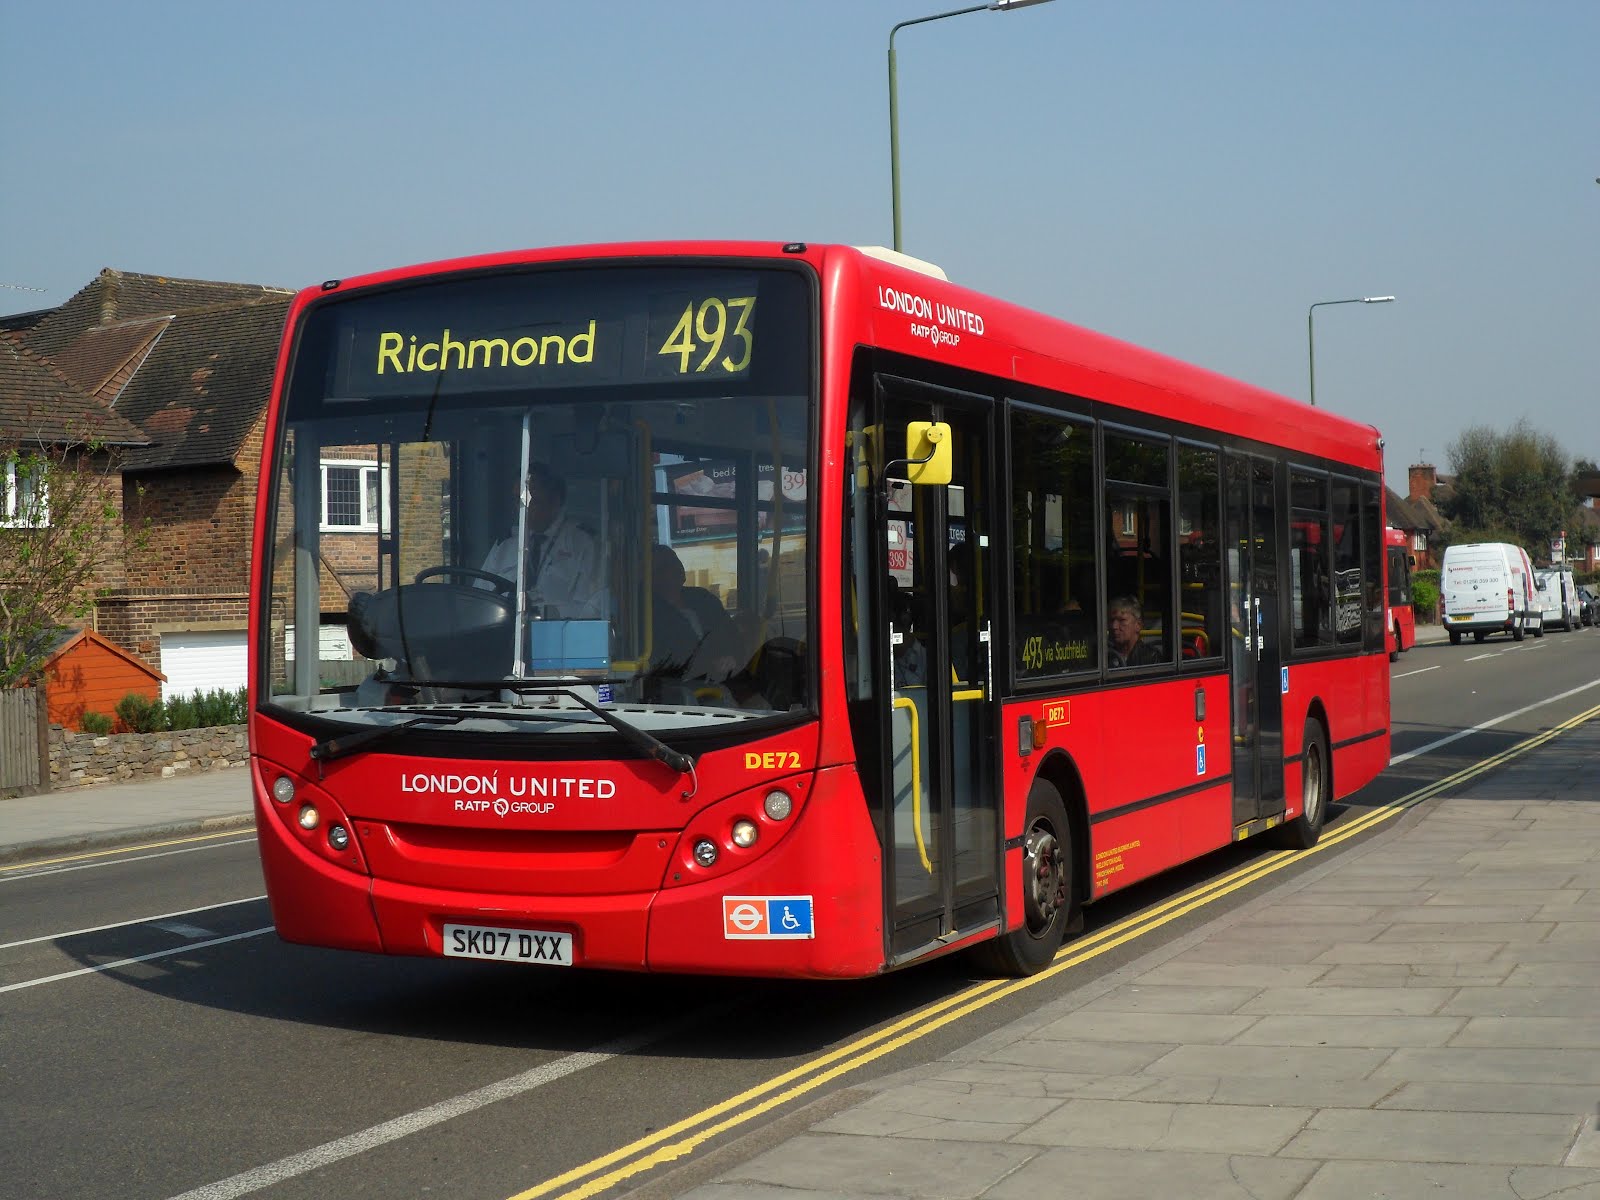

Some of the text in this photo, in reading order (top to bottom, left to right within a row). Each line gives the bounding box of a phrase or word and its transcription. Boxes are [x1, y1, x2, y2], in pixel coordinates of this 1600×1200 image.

[878, 285, 985, 336] LONDON UNITED
[377, 319, 596, 375] Richmond
[658, 296, 758, 374] 493
[910, 322, 960, 347] RATP GROUP
[712, 466, 730, 478] bed
[1022, 636, 1043, 670] 493
[1044, 644, 1054, 661] via
[1049, 706, 1065, 721] DE72
[744, 752, 801, 769] DE72
[401, 773, 616, 799] LONDON UNITED
[454, 800, 555, 814] RATP GROUP
[452, 929, 562, 961] SK07 DXX
